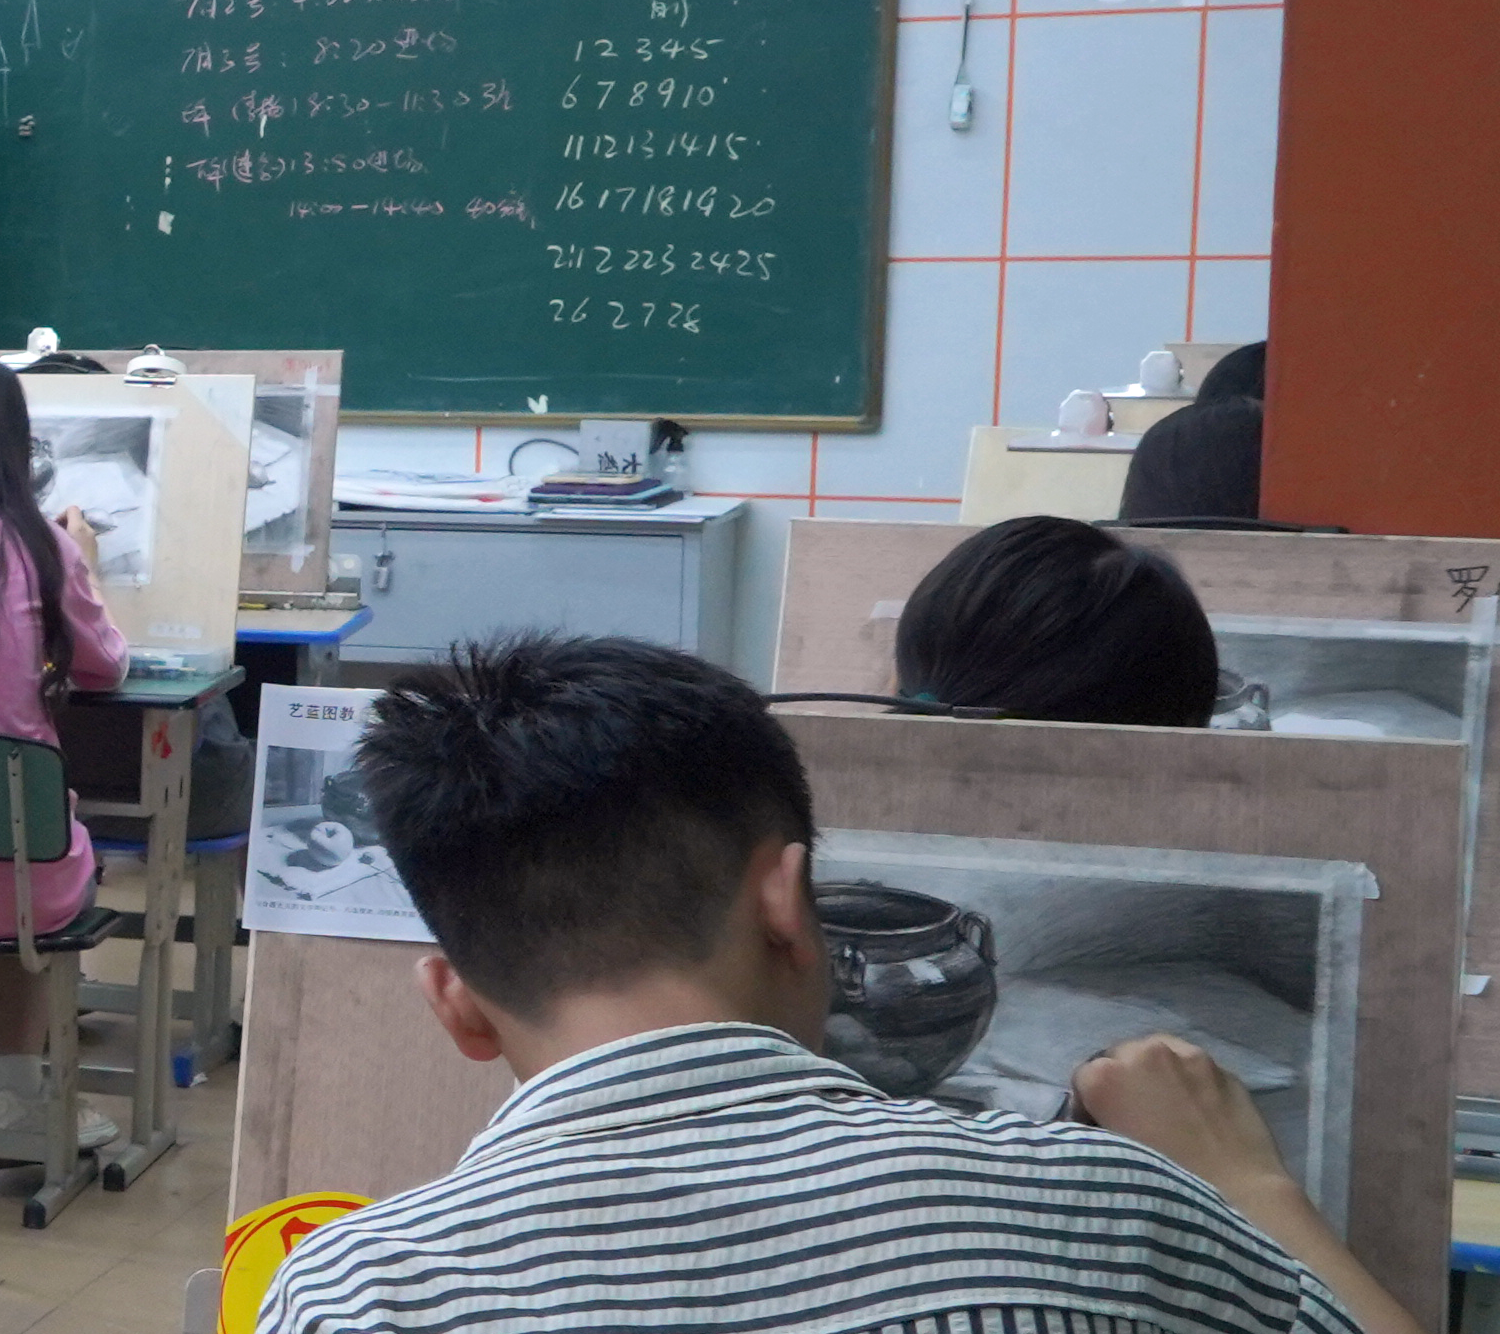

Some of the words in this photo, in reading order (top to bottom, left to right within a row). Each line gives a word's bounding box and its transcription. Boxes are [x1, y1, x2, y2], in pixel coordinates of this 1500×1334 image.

[575, 41, 583, 62] 1
[595, 39, 618, 57] 2
[636, 38, 652, 62] 3
[660, 39, 684, 59] 4
[690, 38, 724, 59] 5
[562, 74, 581, 109] 6
[596, 81, 616, 109] 7
[629, 81, 648, 107] 8
[658, 78, 675, 108] 9
[682, 85, 714, 109] 10
[564, 134, 584, 160] 11
[593, 134, 618, 159] 12
[627, 130, 654, 159] 13
[666, 132, 700, 157] 14
[707, 132, 748, 160] 15
[555, 182, 584, 210] 16
[598, 187, 636, 212] 17
[642, 185, 675, 216] 18
[683, 186, 718, 217] 19
[729, 195, 775, 218] 20
[549, 297, 590, 322] 26
[608, 301, 655, 329] 27
[668, 302, 700, 333] 28
